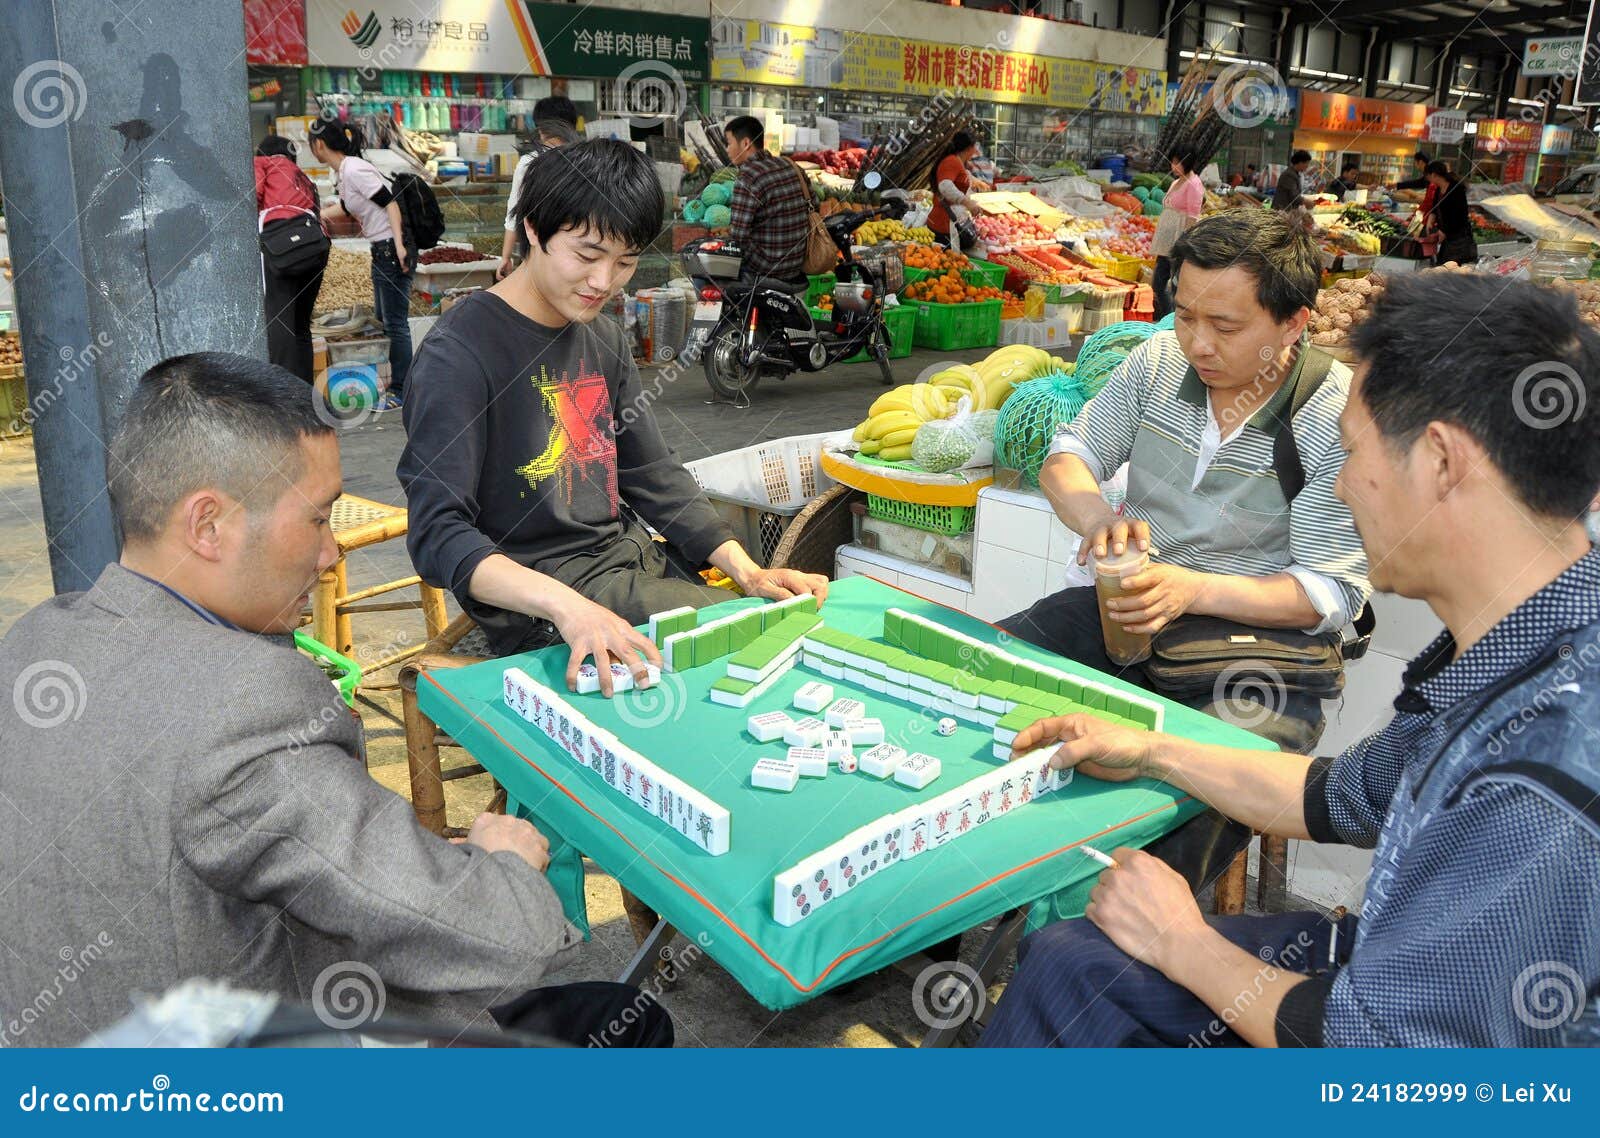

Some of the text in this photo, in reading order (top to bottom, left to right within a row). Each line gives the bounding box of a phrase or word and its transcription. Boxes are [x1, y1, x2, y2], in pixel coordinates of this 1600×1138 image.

[390, 16, 488, 41] 裕华食品
[573, 28, 692, 61] 冷鲜肉销售点
